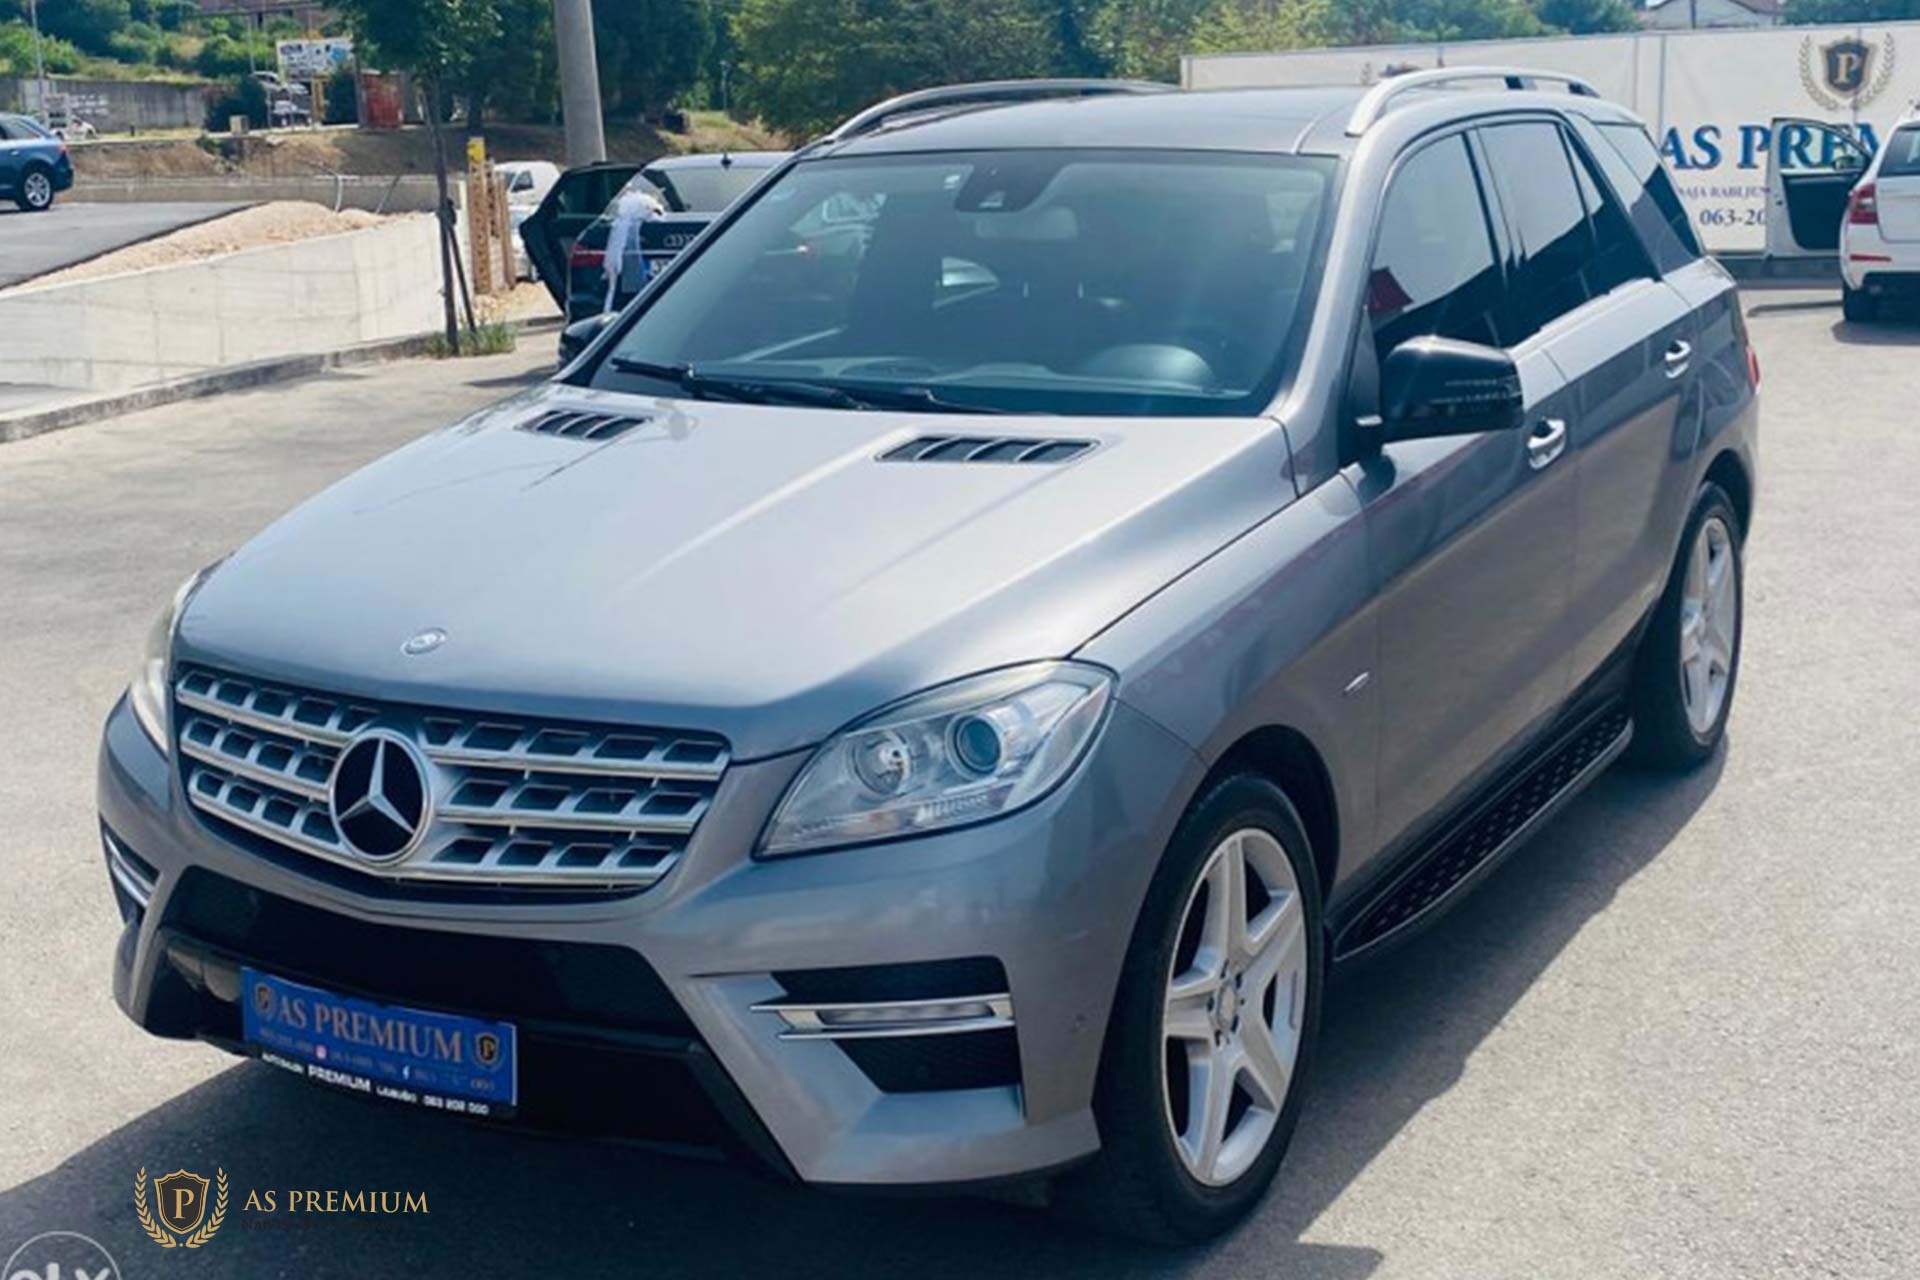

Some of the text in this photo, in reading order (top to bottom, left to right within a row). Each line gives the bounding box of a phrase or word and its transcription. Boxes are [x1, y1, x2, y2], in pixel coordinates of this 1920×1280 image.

[1834, 52, 1860, 84] P
[1661, 124, 1722, 170] AS
[279, 995, 307, 1029] AS
[314, 1002, 464, 1063] PREMIUM
